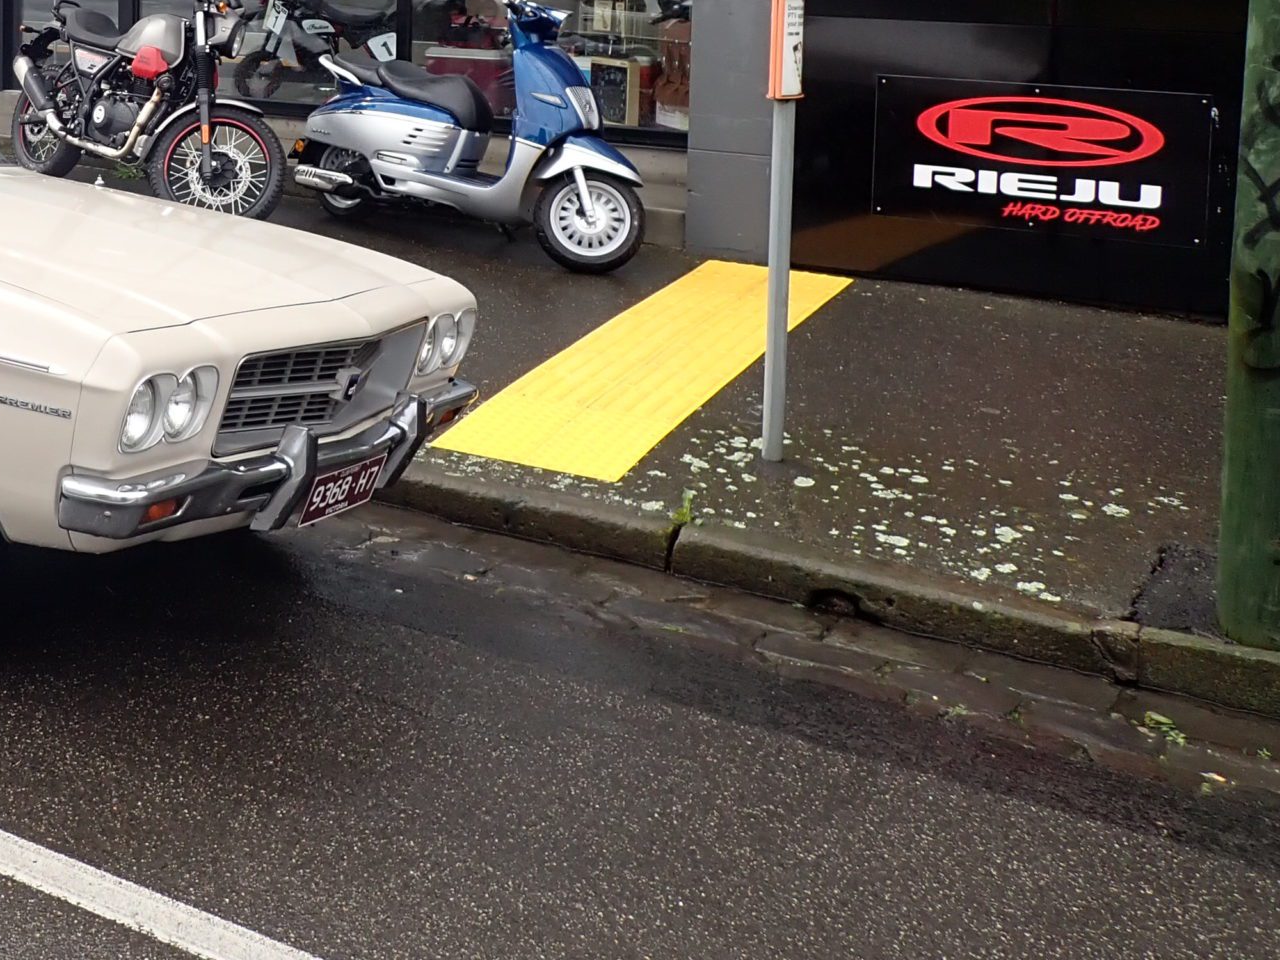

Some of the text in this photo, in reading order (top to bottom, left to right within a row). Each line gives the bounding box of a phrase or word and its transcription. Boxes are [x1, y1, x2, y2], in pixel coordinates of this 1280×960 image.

[380, 40, 394, 57] 1
[913, 163, 1162, 209] RIEJU
[1001, 201, 1161, 232] HARD OFFROAD
